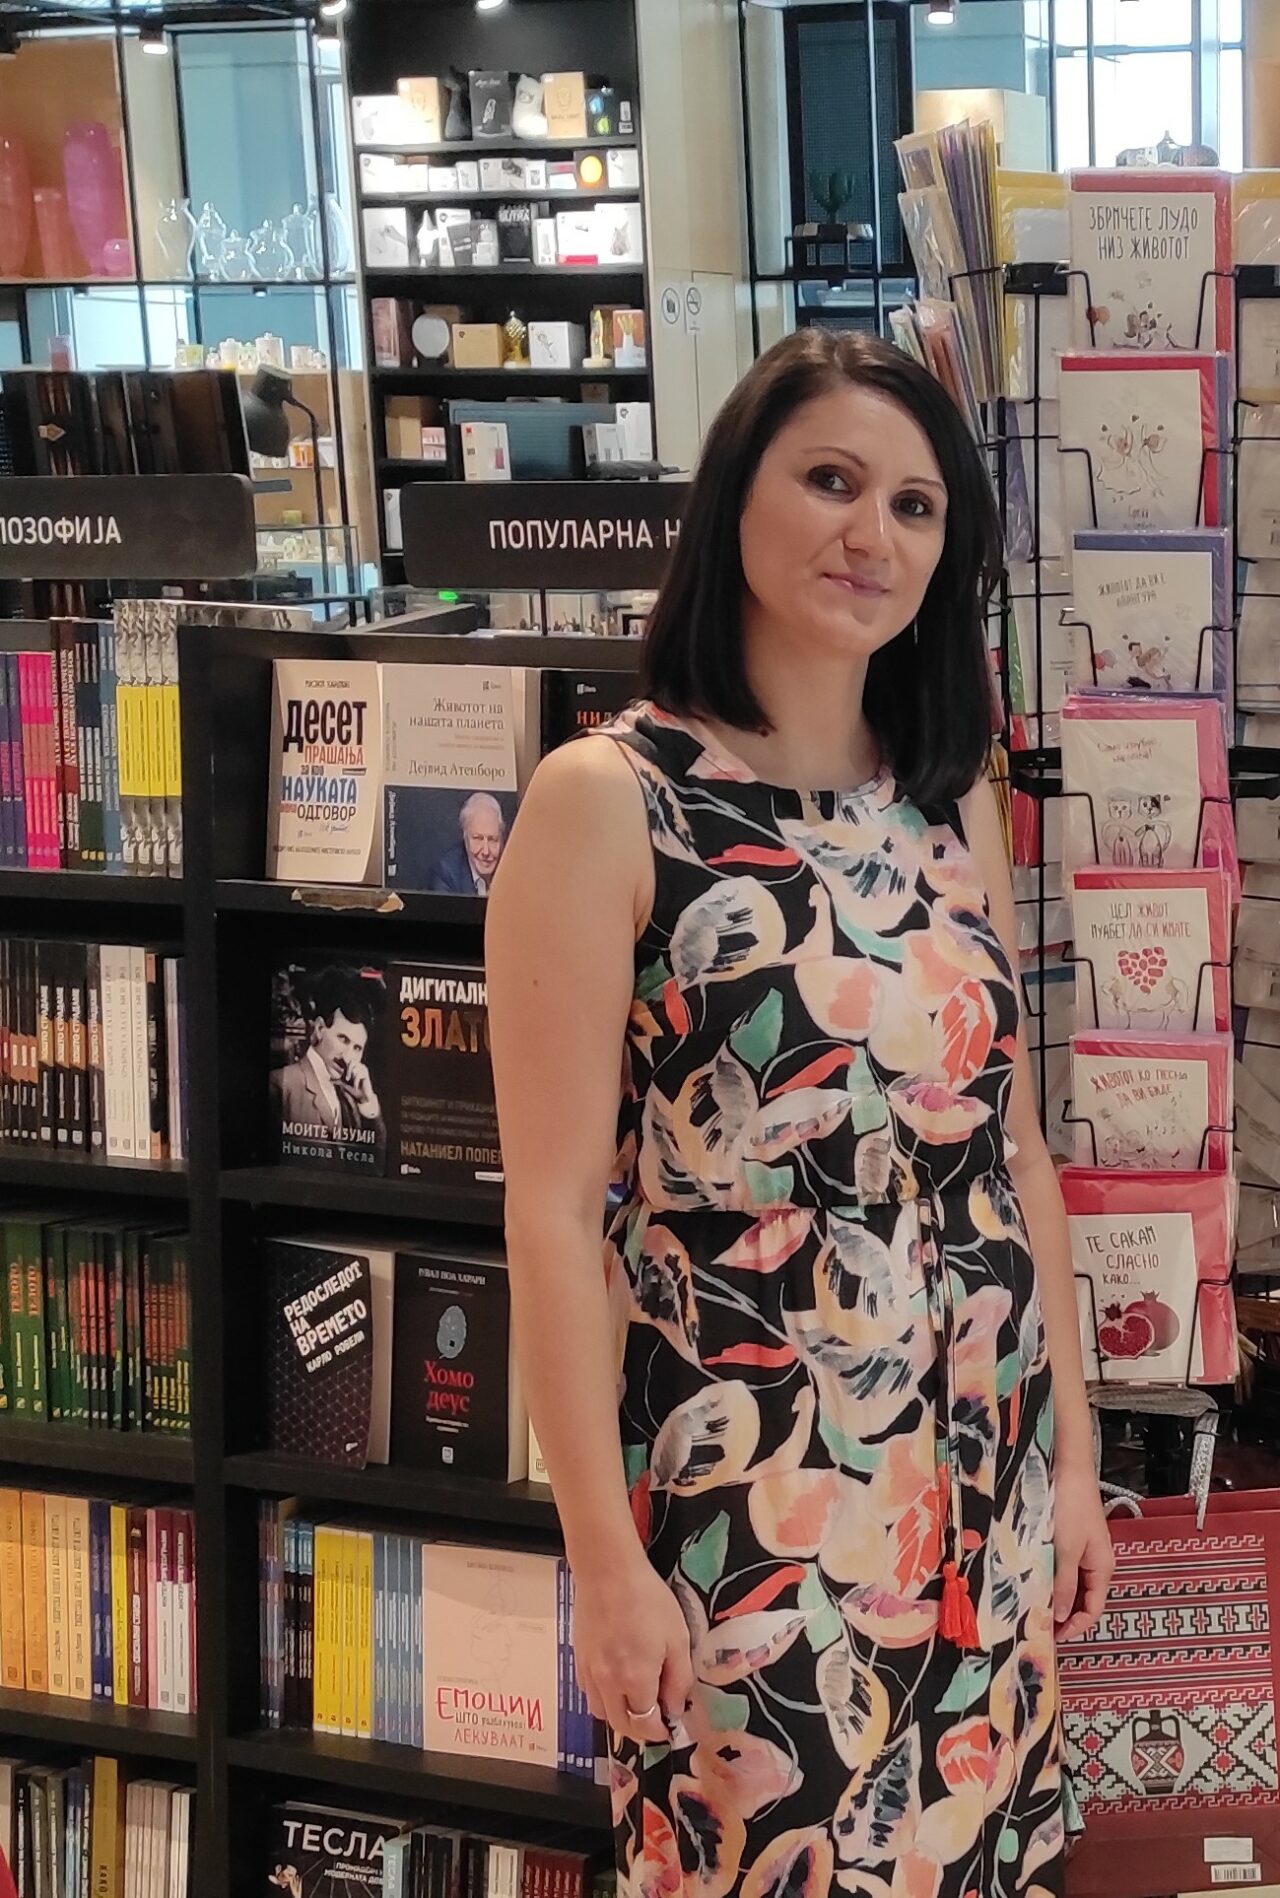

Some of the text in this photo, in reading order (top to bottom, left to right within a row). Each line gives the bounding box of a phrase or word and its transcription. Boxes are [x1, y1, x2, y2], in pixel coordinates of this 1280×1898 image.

[1158, 206, 1198, 232] ЛУДО
[1098, 236, 1189, 260] НИЗ ЖИВОТОТ
[489, 519, 653, 550] ПОПУЛАРНА
[433, 698, 503, 714] Животот на
[409, 716, 505, 730] нашата планета
[305, 745, 364, 765] ПРАШАЊА
[408, 760, 506, 781] Дејвид Атенборо
[282, 776, 357, 804] НАУКАТА
[297, 804, 357, 821] ОДГОВОР
[1110, 902, 1169, 919] ЦЕЛ ЖИВОТ
[1091, 921, 1192, 940] МУАБЕТ ДА СИ ИМАТЕ
[1090, 1069, 1134, 1094] ЖИВОТОТ
[1138, 1069, 1151, 1083] КО
[282, 1121, 375, 1144] МОИТЕ ИЗУМИ
[282, 1141, 375, 1163] Никола Тесла
[400, 1141, 462, 1161] НАТАНИЕЛ
[1085, 1225, 1157, 1253] ТЕ САКАМ
[1106, 1253, 1159, 1270] СЛАСНО
[283, 1260, 364, 1321] РЕДОСЛЕДОТ
[289, 1317, 311, 1338] НА
[296, 1298, 368, 1357] ВРЕМЕТО
[424, 1360, 474, 1389] Хомо
[426, 1391, 470, 1416] деус
[436, 1687, 542, 1731] ЕМОЦИИ
[455, 1711, 479, 1725] ШТО
[454, 1728, 525, 1748] ЛЕКУВААТ
[283, 1820, 385, 1860] ТЕСЛА
